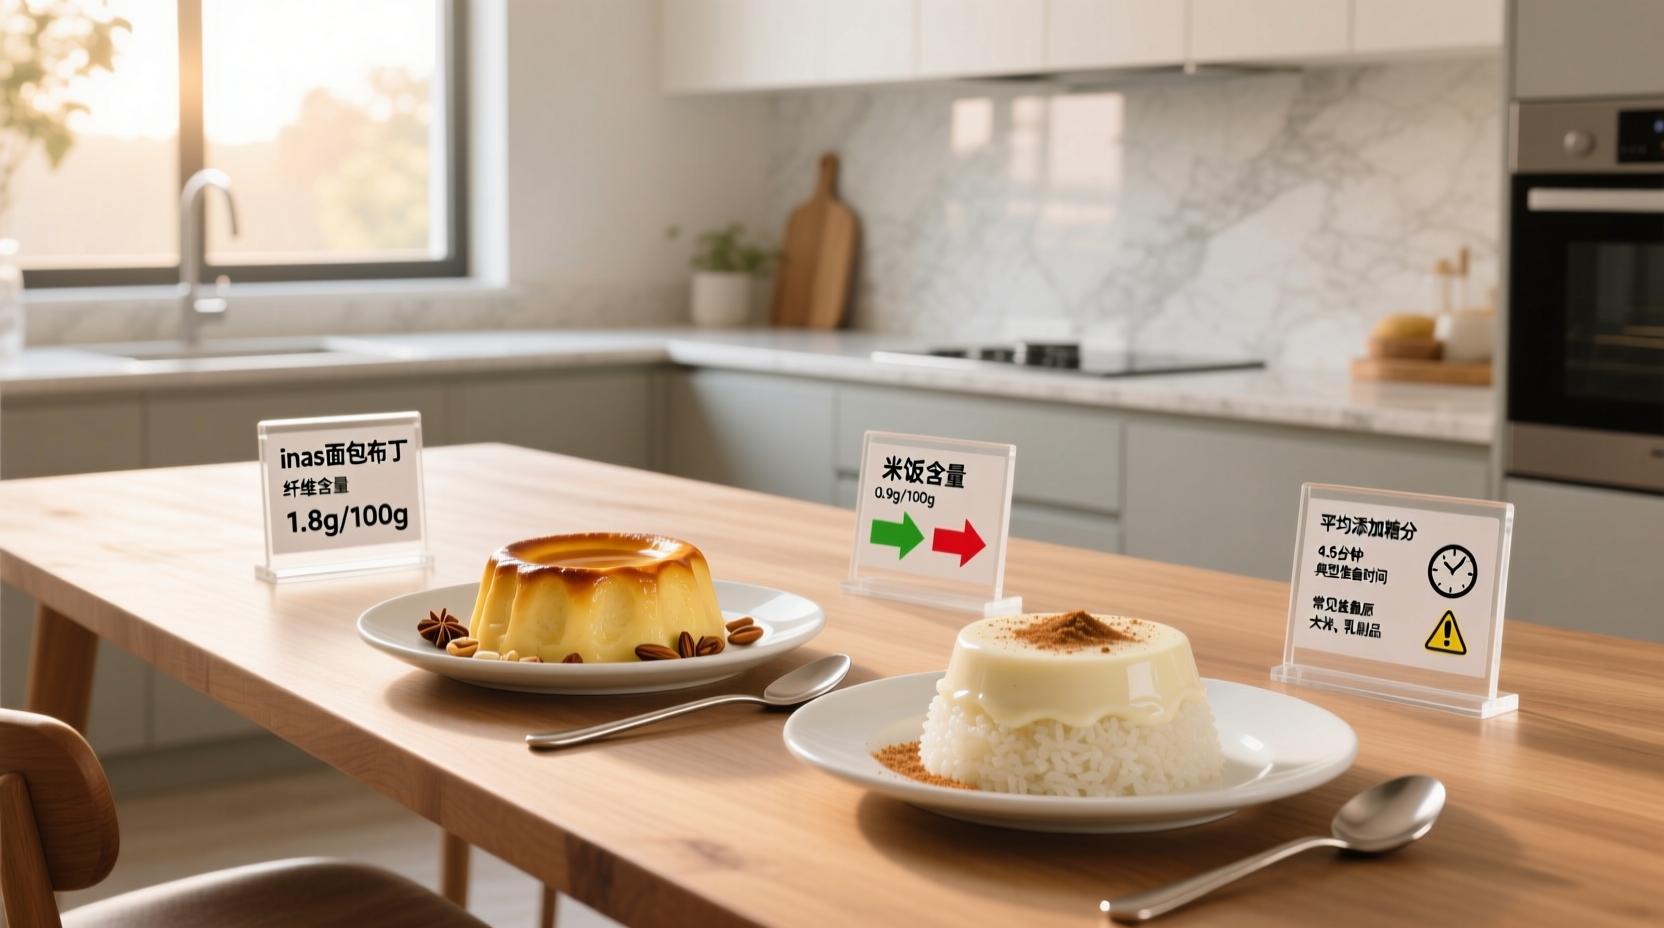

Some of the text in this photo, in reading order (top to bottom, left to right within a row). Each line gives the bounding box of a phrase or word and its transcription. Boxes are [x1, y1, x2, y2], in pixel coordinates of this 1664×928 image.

[280, 439, 408, 469] inas面包布丁
[283, 475, 349, 498] 纤维含量
[882, 455, 967, 489] 米饭含量
[874, 486, 935, 509] 0.9g/100g
[287, 503, 408, 537] 1.8g/100g
